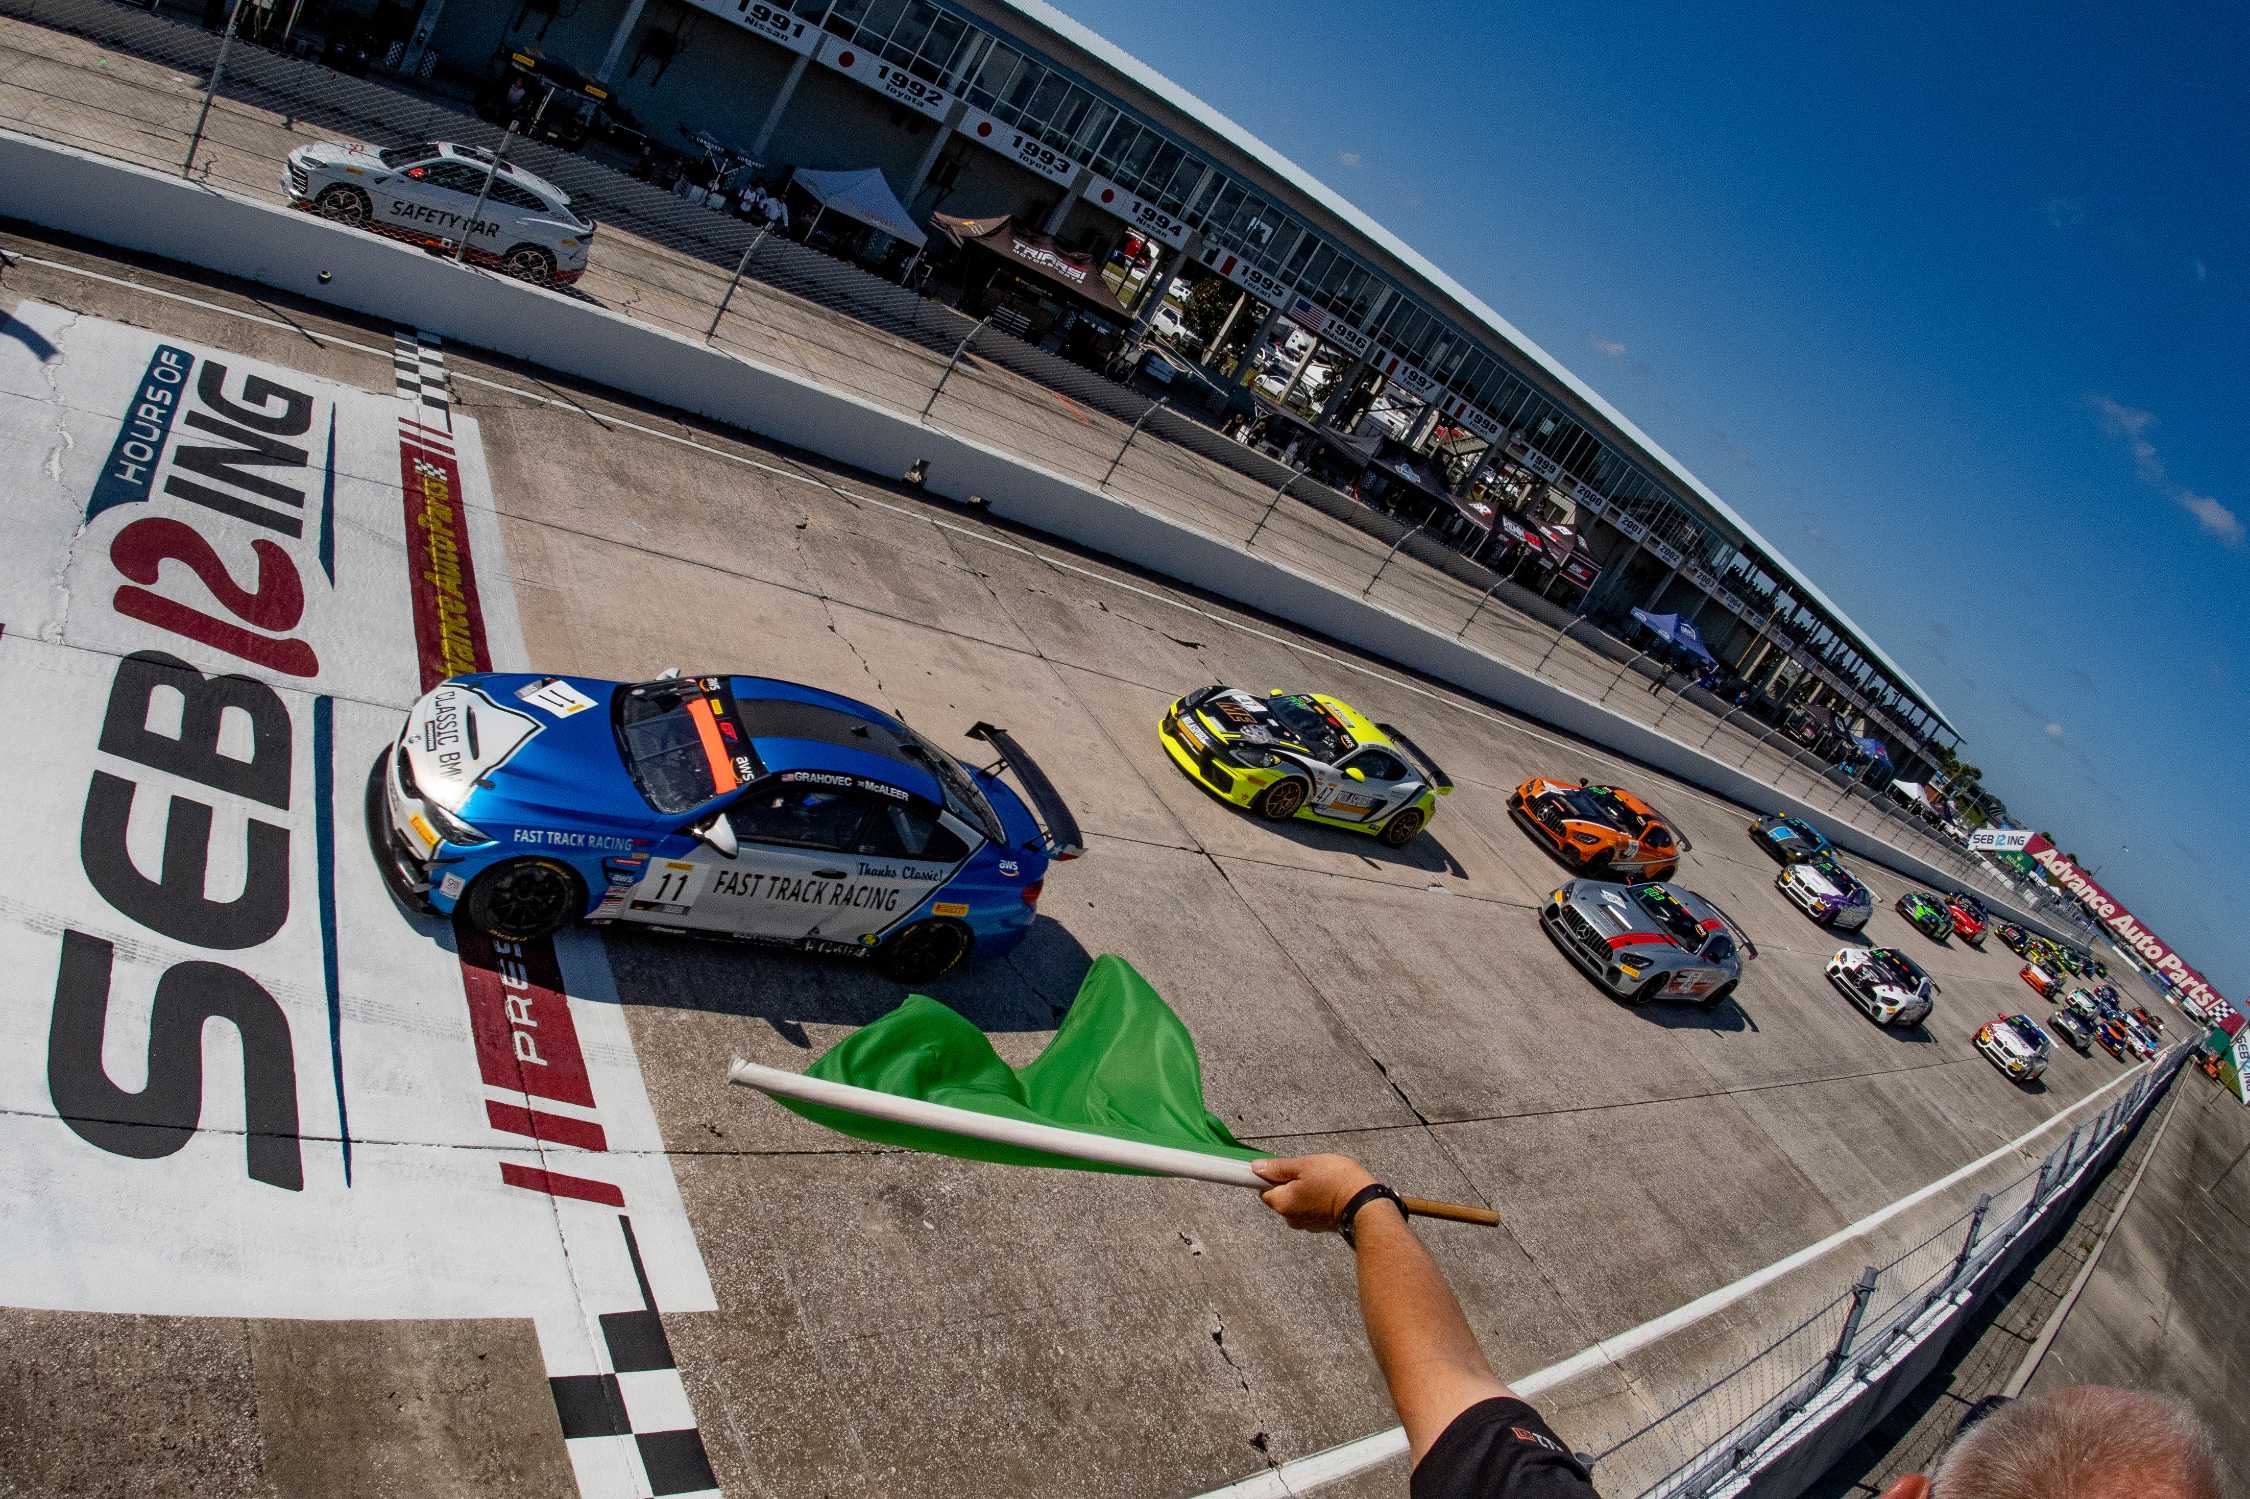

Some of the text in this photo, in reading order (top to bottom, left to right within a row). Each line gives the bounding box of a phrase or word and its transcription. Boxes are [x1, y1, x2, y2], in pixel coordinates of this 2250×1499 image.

[737, 0, 804, 38] 1991
[744, 15, 789, 43] Nissan
[877, 64, 943, 107] 1992
[885, 83, 925, 108] Toyota
[1011, 134, 1071, 174] 1993
[1019, 152, 1053, 175] Toyota
[389, 200, 462, 228] SAFETY
[1131, 201, 1183, 237] 1994
[1136, 216, 1168, 239] Nissan
[1241, 264, 1286, 298] 1995
[1326, 319, 1368, 350] 1996
[1401, 364, 1436, 391] 1997
[114, 349, 184, 486] HOURS OF
[1468, 410, 1499, 435] 1998
[1530, 453, 1557, 474] 1999
[1577, 484, 1603, 506] 2000
[1622, 516, 1643, 535] 2001
[538, 689, 576, 708] 11
[435, 690, 464, 783] CLASSIC BM
[735, 755, 756, 782] aws
[794, 771, 910, 802] GRAHOVEC McALEER
[513, 828, 633, 852] FAST TRACK RACING
[858, 861, 944, 882] Thanks Classic!
[999, 859, 1019, 871] aws
[655, 873, 689, 902] 11
[713, 869, 899, 913] FAST TRACK RACING
[2031, 848, 2216, 1007] Advance Auto Parts
